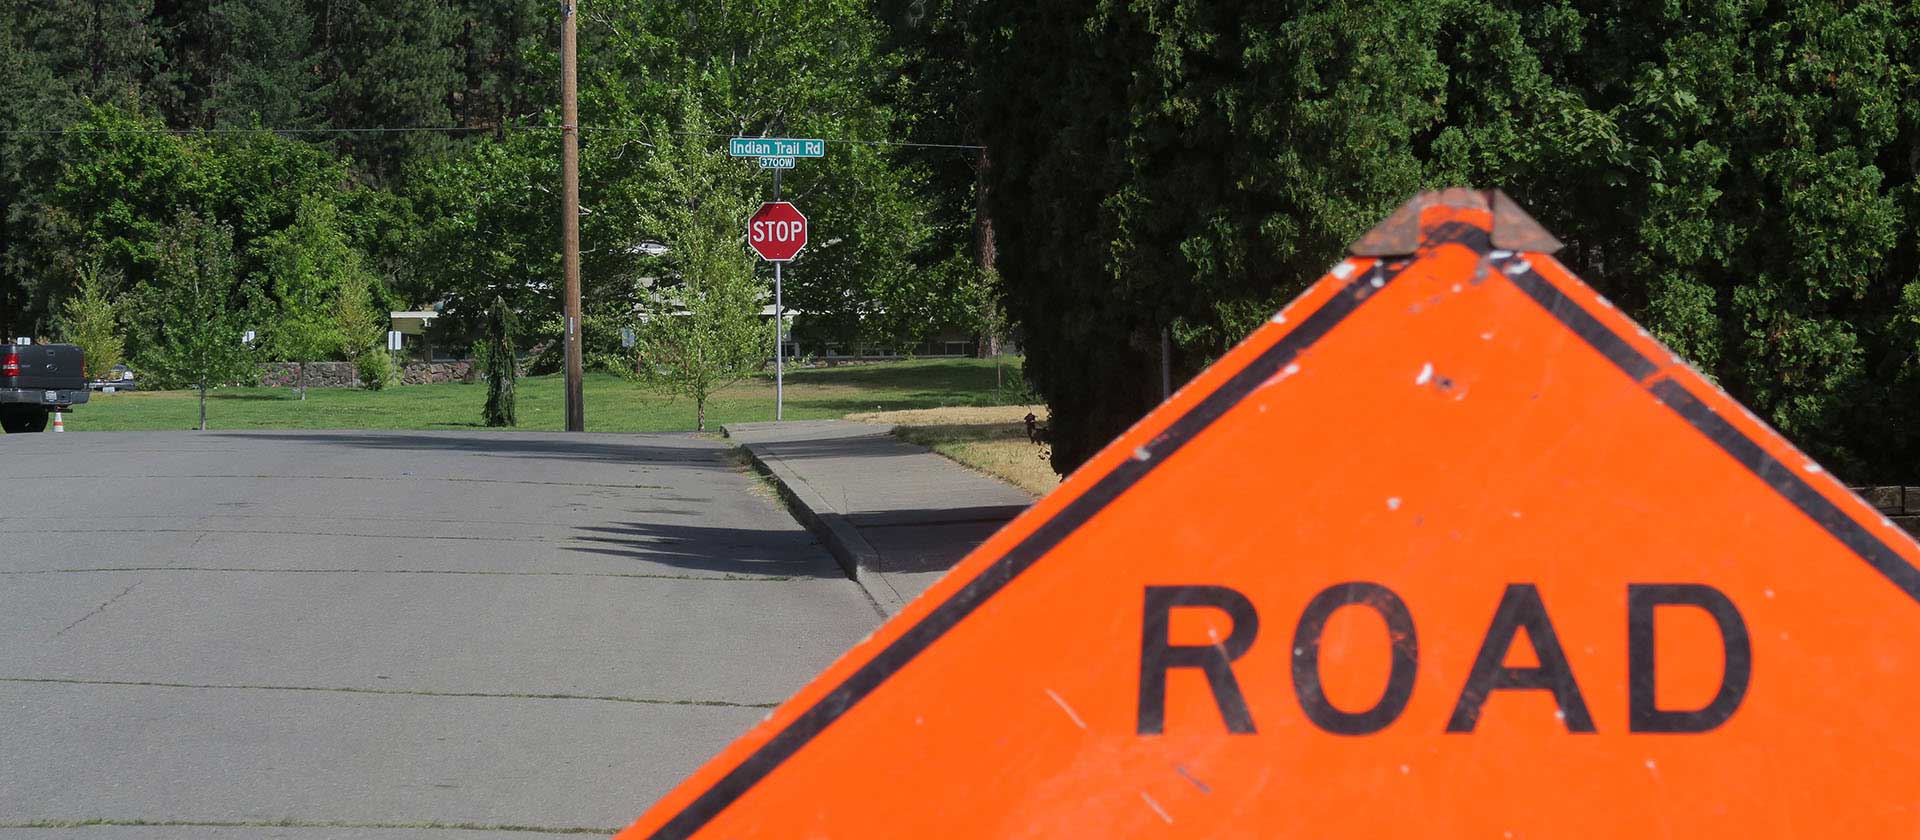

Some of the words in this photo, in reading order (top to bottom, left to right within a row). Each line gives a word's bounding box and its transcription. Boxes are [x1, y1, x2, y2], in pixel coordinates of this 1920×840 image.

[733, 141, 770, 154] Indian
[775, 141, 799, 154] Trail
[805, 142, 820, 154] Rd
[761, 158, 792, 167] 3700W
[753, 220, 803, 242] STOP
[1136, 581, 1752, 736] ROAD
